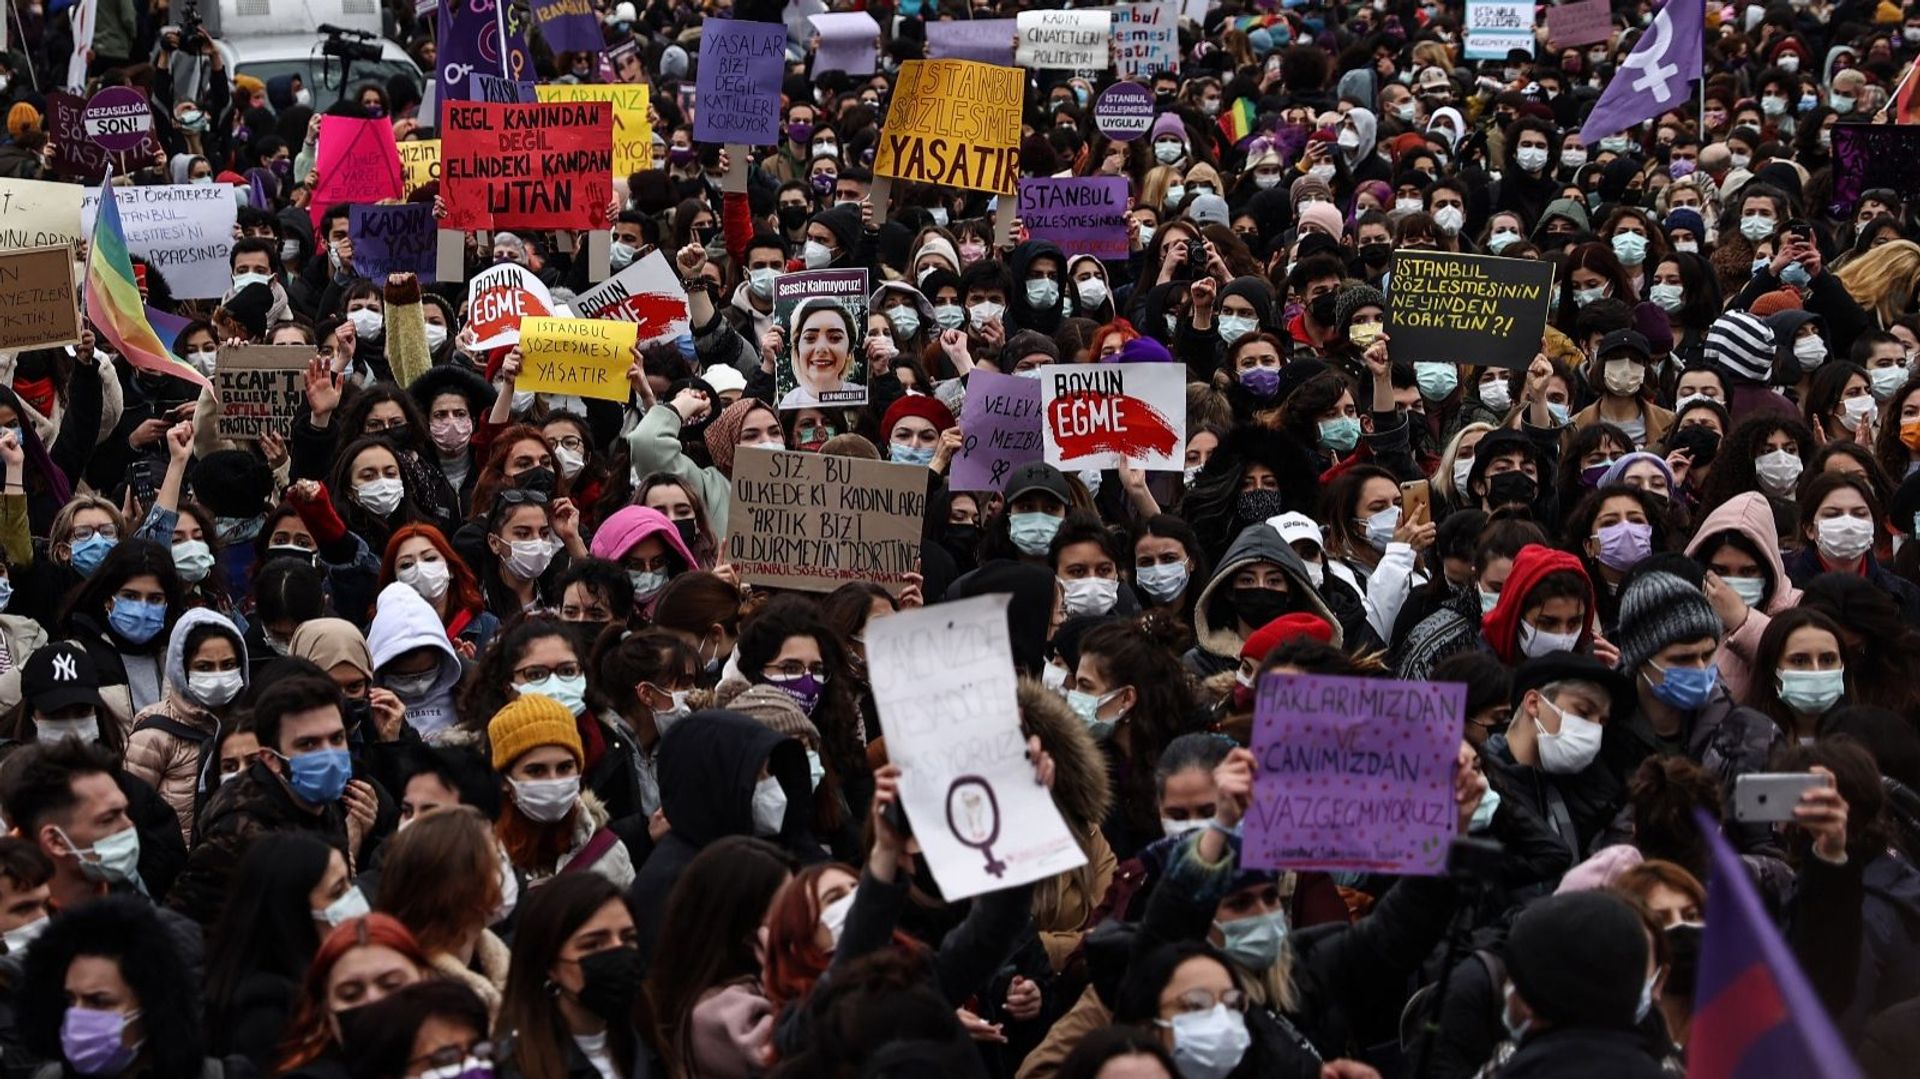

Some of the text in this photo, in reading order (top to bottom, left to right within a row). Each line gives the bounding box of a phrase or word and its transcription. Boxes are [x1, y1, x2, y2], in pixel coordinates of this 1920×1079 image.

[1042, 13, 1079, 25] KADIN
[708, 34, 785, 57] YASALAR
[87, 102, 148, 117] CEZASIZLIĞA
[1105, 93, 1147, 104] İSTANBUL
[97, 117, 138, 134] SON!
[450, 107, 493, 130] REGL
[503, 106, 599, 130] KANINDAN
[708, 113, 769, 133] KORUYOR
[1102, 117, 1144, 129] UYGULA!
[499, 128, 553, 151] DEĞİL
[542, 150, 610, 177] KANDAN
[890, 135, 1020, 195] YAŞATIR
[488, 180, 572, 214] UTAN
[1017, 182, 1114, 210] İSTANBUL
[361, 207, 426, 240] KADIN
[1396, 258, 1488, 279] İSTANBUL
[475, 268, 524, 300] BOYUN
[779, 278, 861, 296] Sessiz Kalmıyoruz!
[1391, 275, 1540, 300] SÖZLEŞMESİNİN
[474, 290, 528, 326] EĞME
[578, 279, 630, 318] BOYUN
[220, 373, 235, 389] I
[1055, 370, 1124, 399] BOYUN
[222, 391, 278, 404] BELIEVE
[223, 404, 269, 416] STILL
[985, 395, 1034, 418] VELEV
[220, 416, 289, 437] PROTEST THIS
[1057, 398, 1127, 437] EĞME
[824, 457, 851, 484] BU
[840, 486, 925, 517] KADINLARA
[820, 511, 862, 540] BİZİ
[1260, 677, 1458, 722] HAKLARIMIZDAN
[1334, 721, 1370, 749] VE
[1264, 741, 1420, 782] CANIMIZDAN
